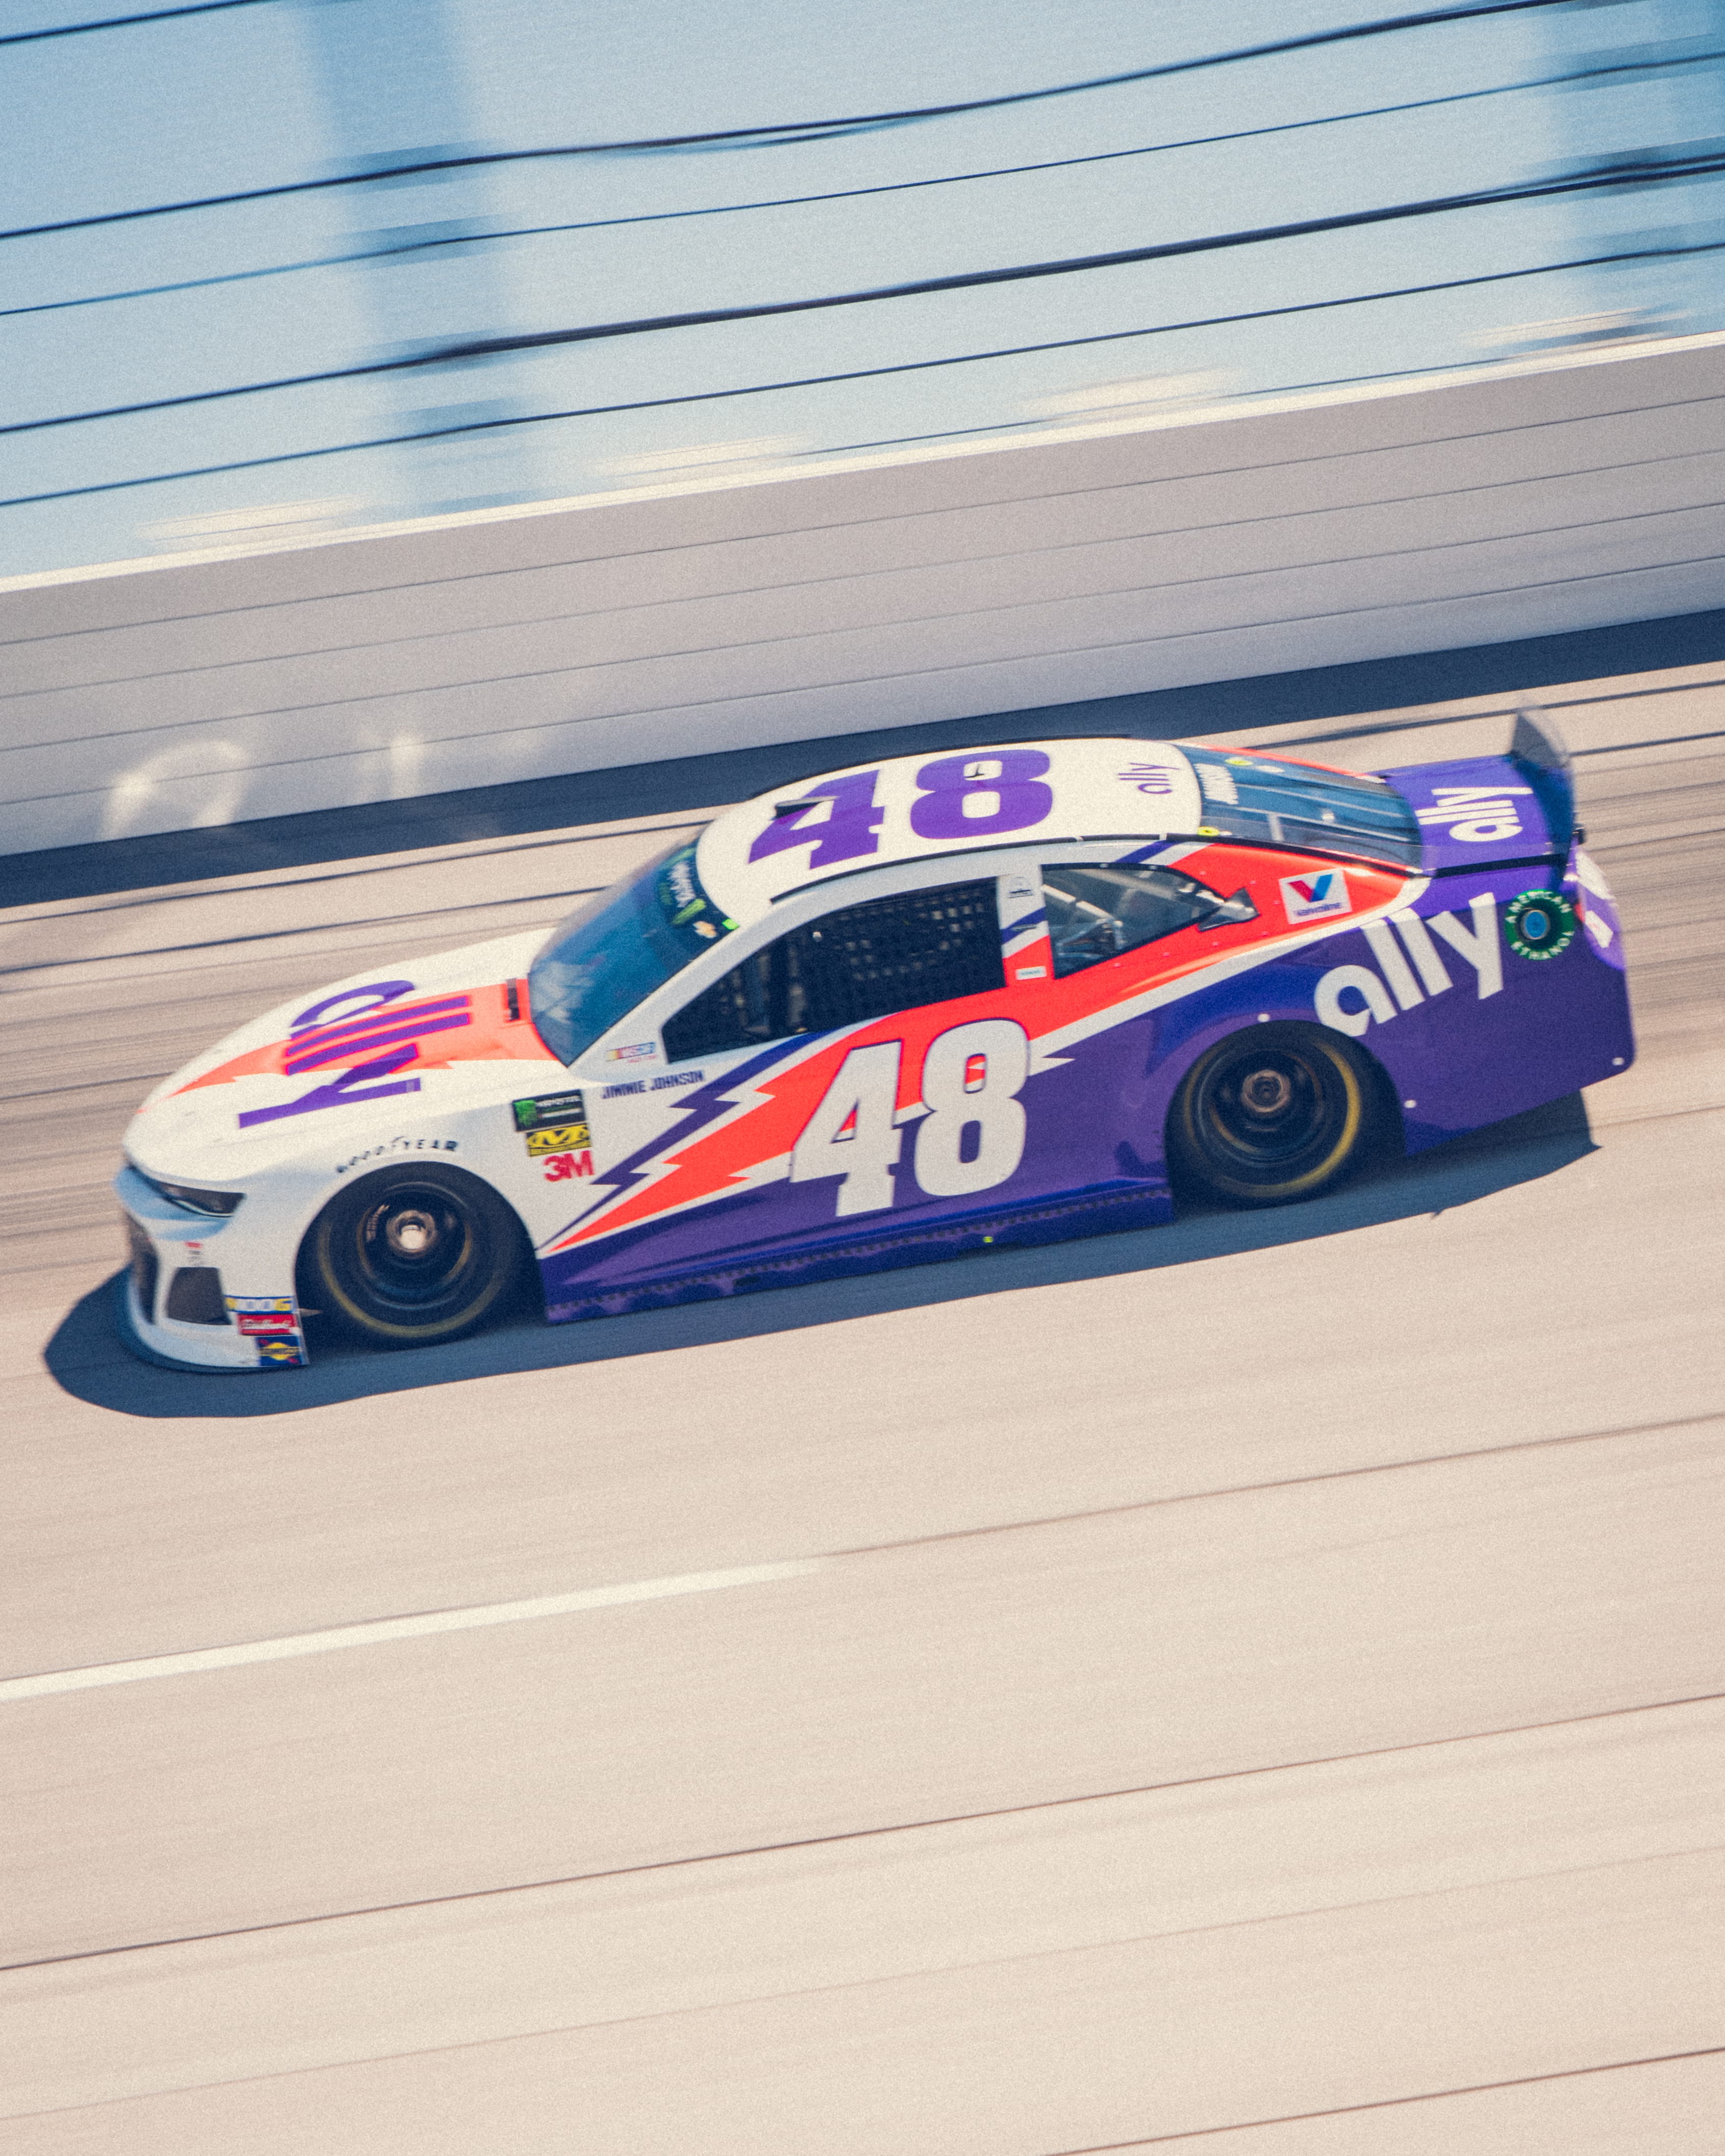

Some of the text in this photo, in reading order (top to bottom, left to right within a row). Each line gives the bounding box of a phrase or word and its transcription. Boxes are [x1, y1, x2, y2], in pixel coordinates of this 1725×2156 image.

[748, 749, 1052, 870] 48
[1118, 762, 1180, 794] ally
[1414, 786, 1534, 842] ally
[1313, 892, 1504, 1036] ally
[239, 980, 472, 1129] ally
[650, 1069, 705, 1091] JOHNSON
[789, 1017, 1030, 1217] 48
[543, 1150, 595, 1182] 3M
